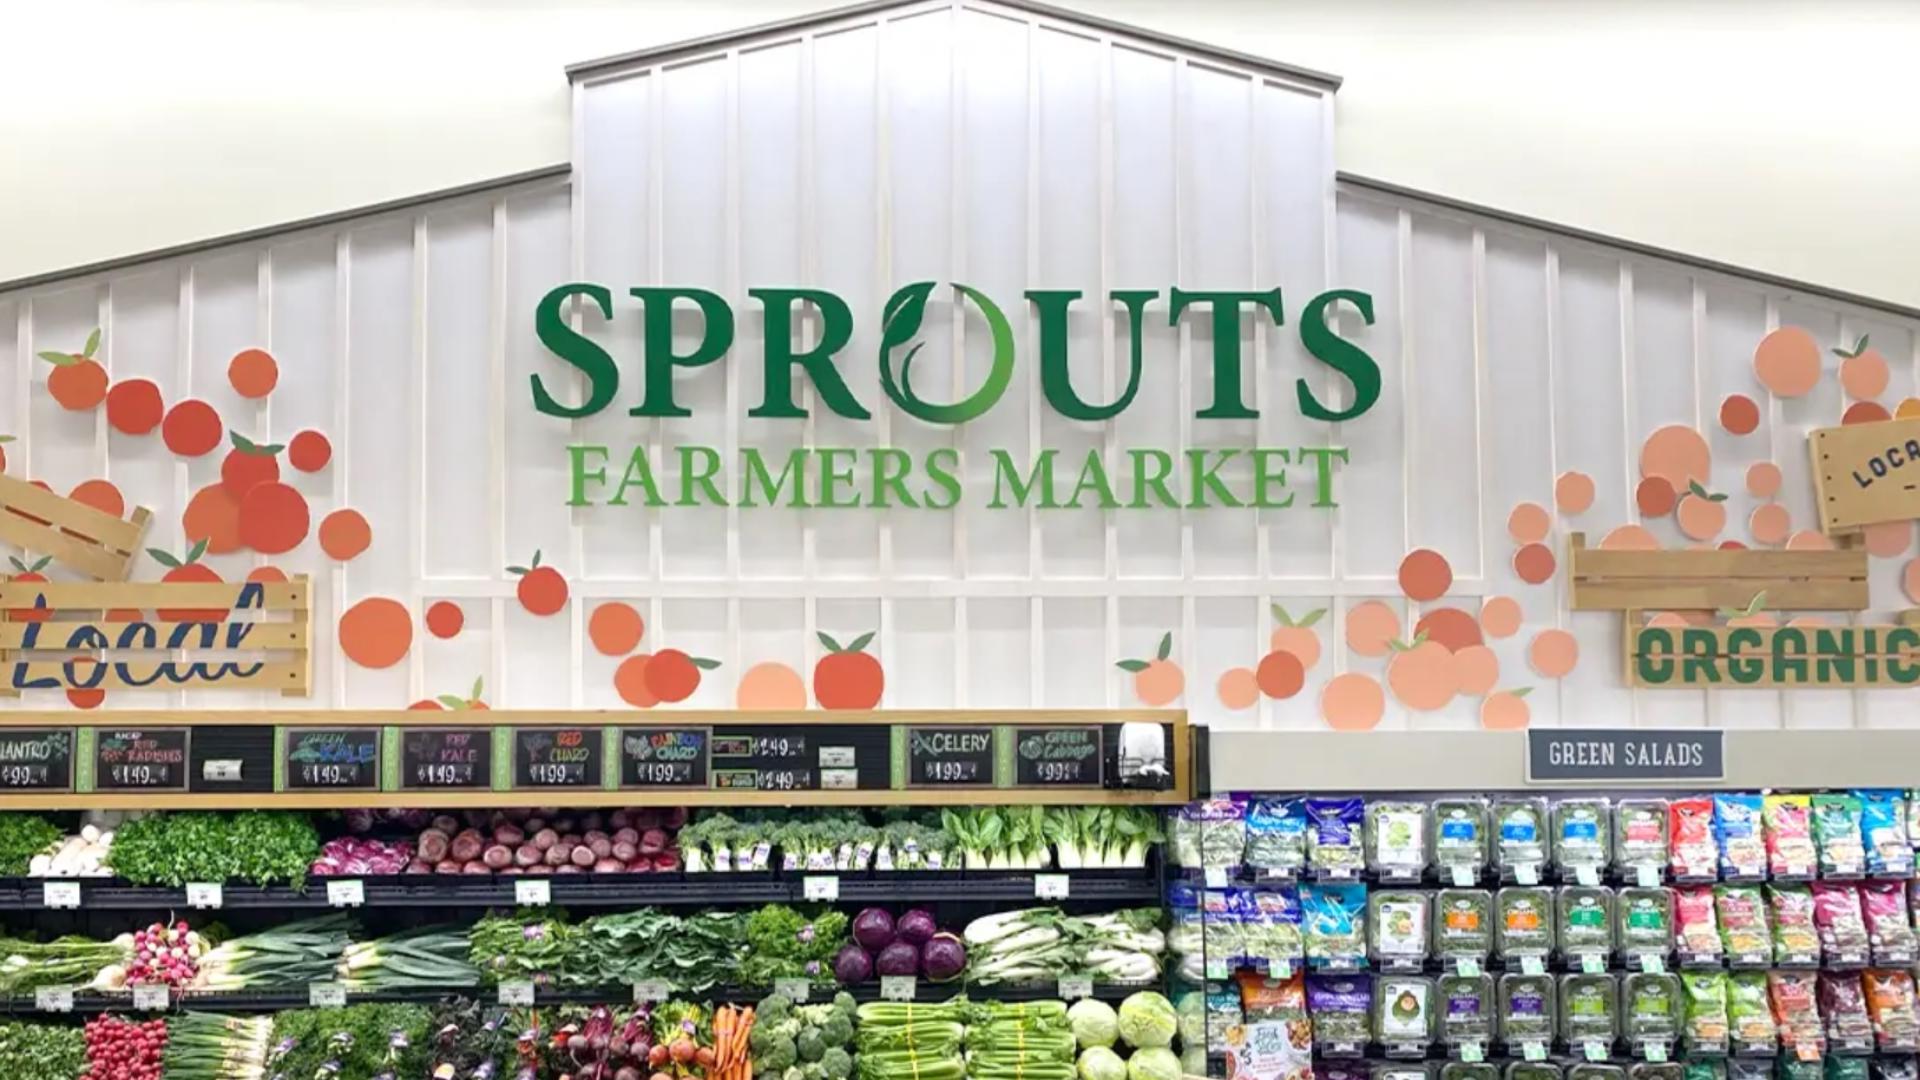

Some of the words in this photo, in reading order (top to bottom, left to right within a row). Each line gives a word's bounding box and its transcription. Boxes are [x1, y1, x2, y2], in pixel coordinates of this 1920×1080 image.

[530, 281, 1382, 424] SPROUTS
[565, 445, 962, 510] FARMERS
[987, 448, 1349, 510] MARKET
[12, 582, 264, 689] Local
[1637, 628, 1920, 684] ORGANIC
[931, 732, 990, 753] CELERY
[1549, 741, 1615, 766] GREEN
[1625, 742, 1703, 767] SALADS
